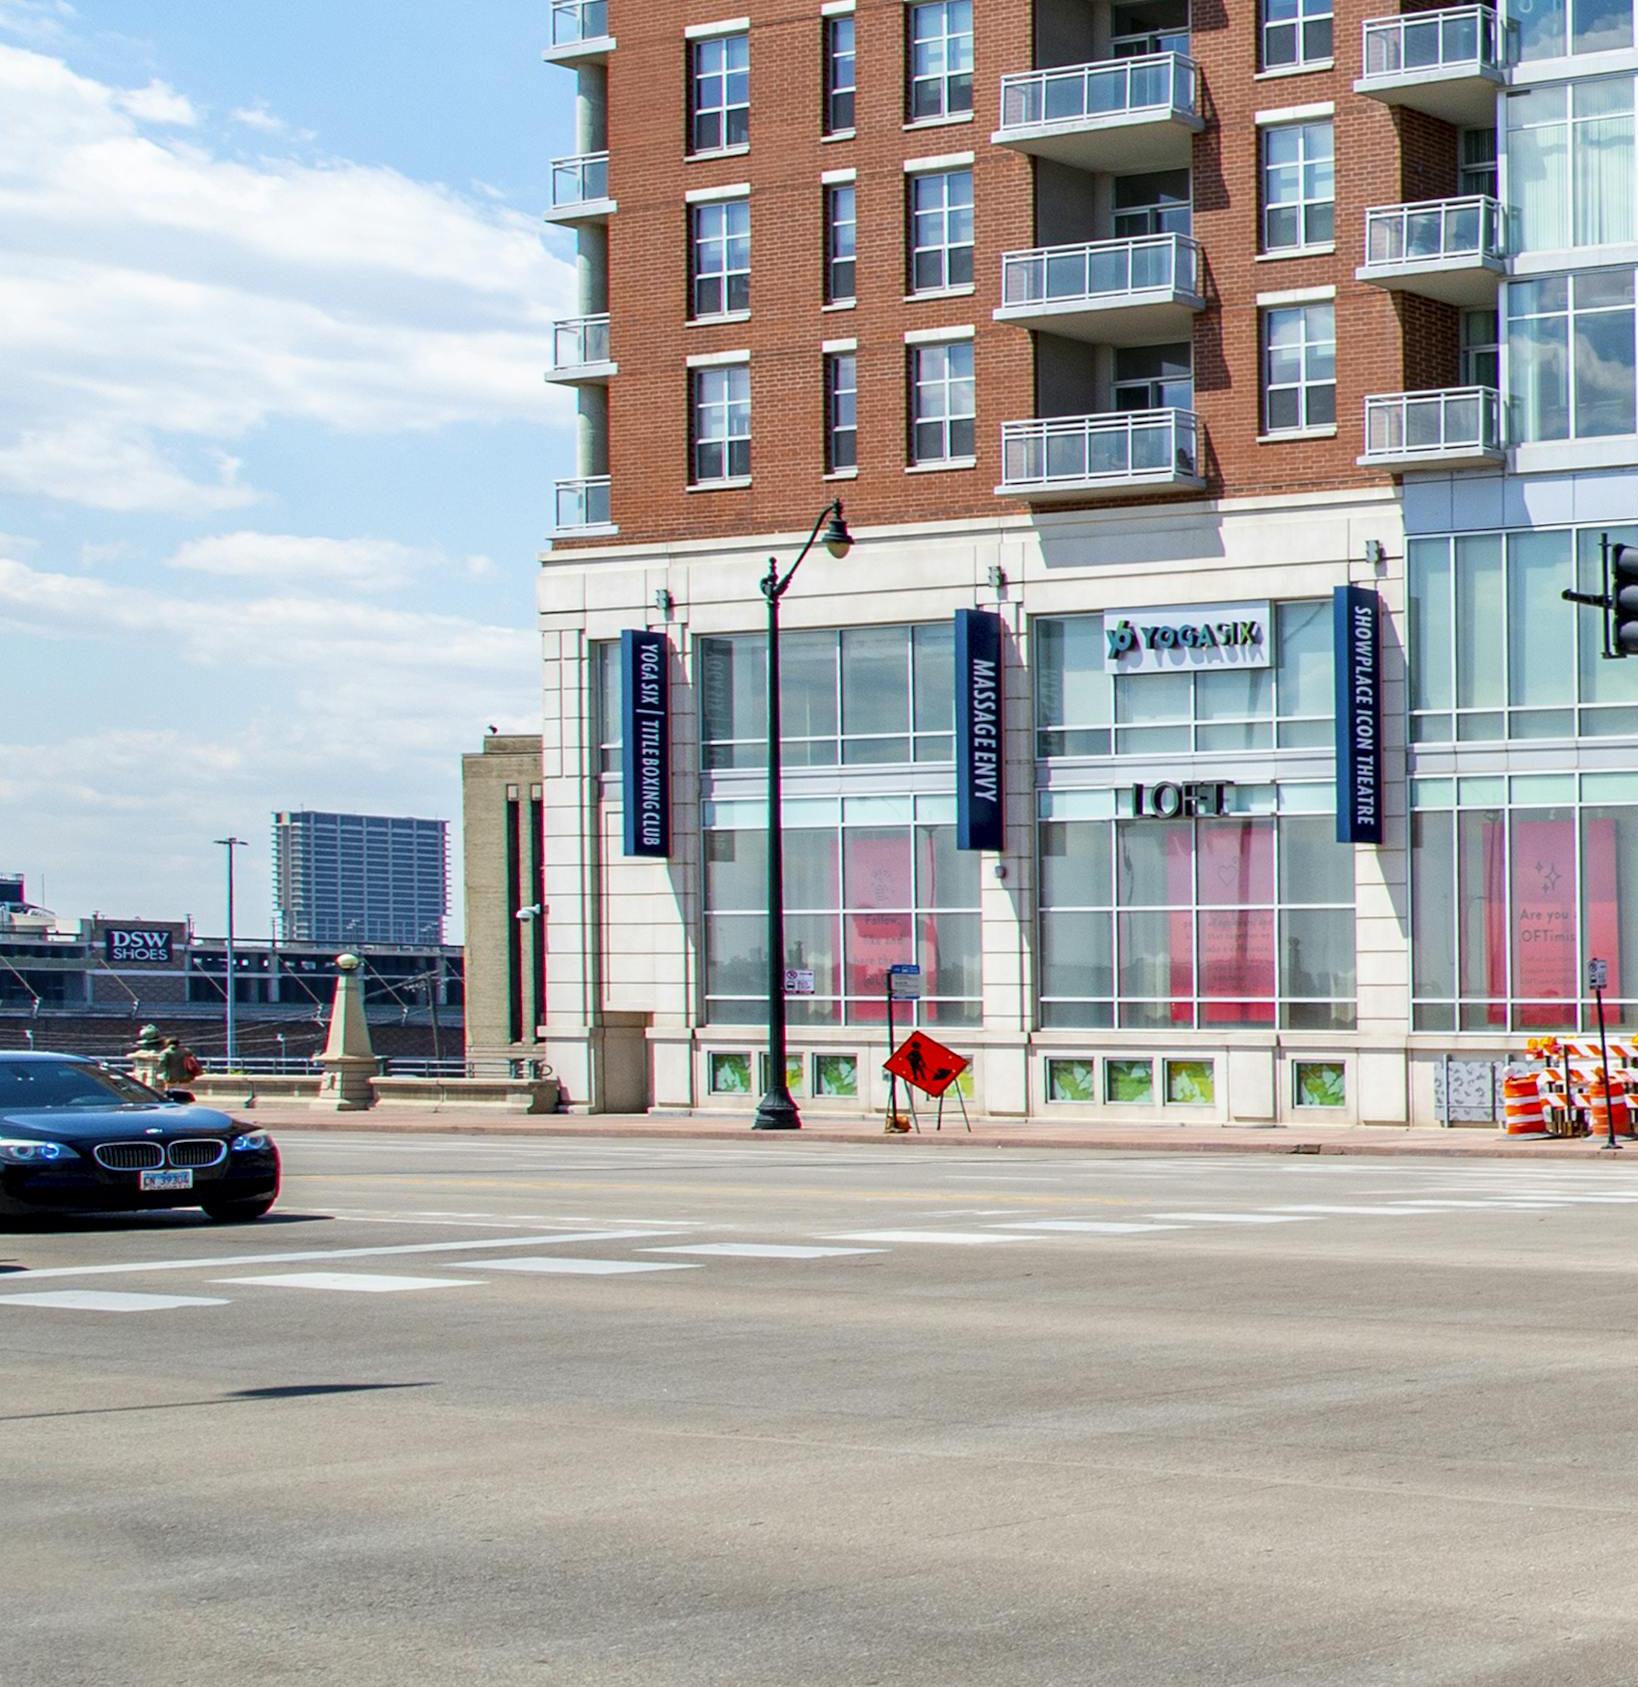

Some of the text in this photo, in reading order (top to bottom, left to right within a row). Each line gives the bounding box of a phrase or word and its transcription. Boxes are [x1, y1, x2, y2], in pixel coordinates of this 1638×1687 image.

[1141, 621, 1257, 650] YOGASIX
[973, 659, 997, 802] MASSAGE ENVY
[1355, 606, 1375, 826] SHOWPLACE ICON THEATRE
[641, 643, 661, 846] YOGA SIX TITLE BOXING CLUB
[1132, 780, 1235, 819] LOFT
[1520, 909, 1568, 924] Are you
[112, 931, 168, 947] DSW
[113, 947, 168, 960] SHOES
